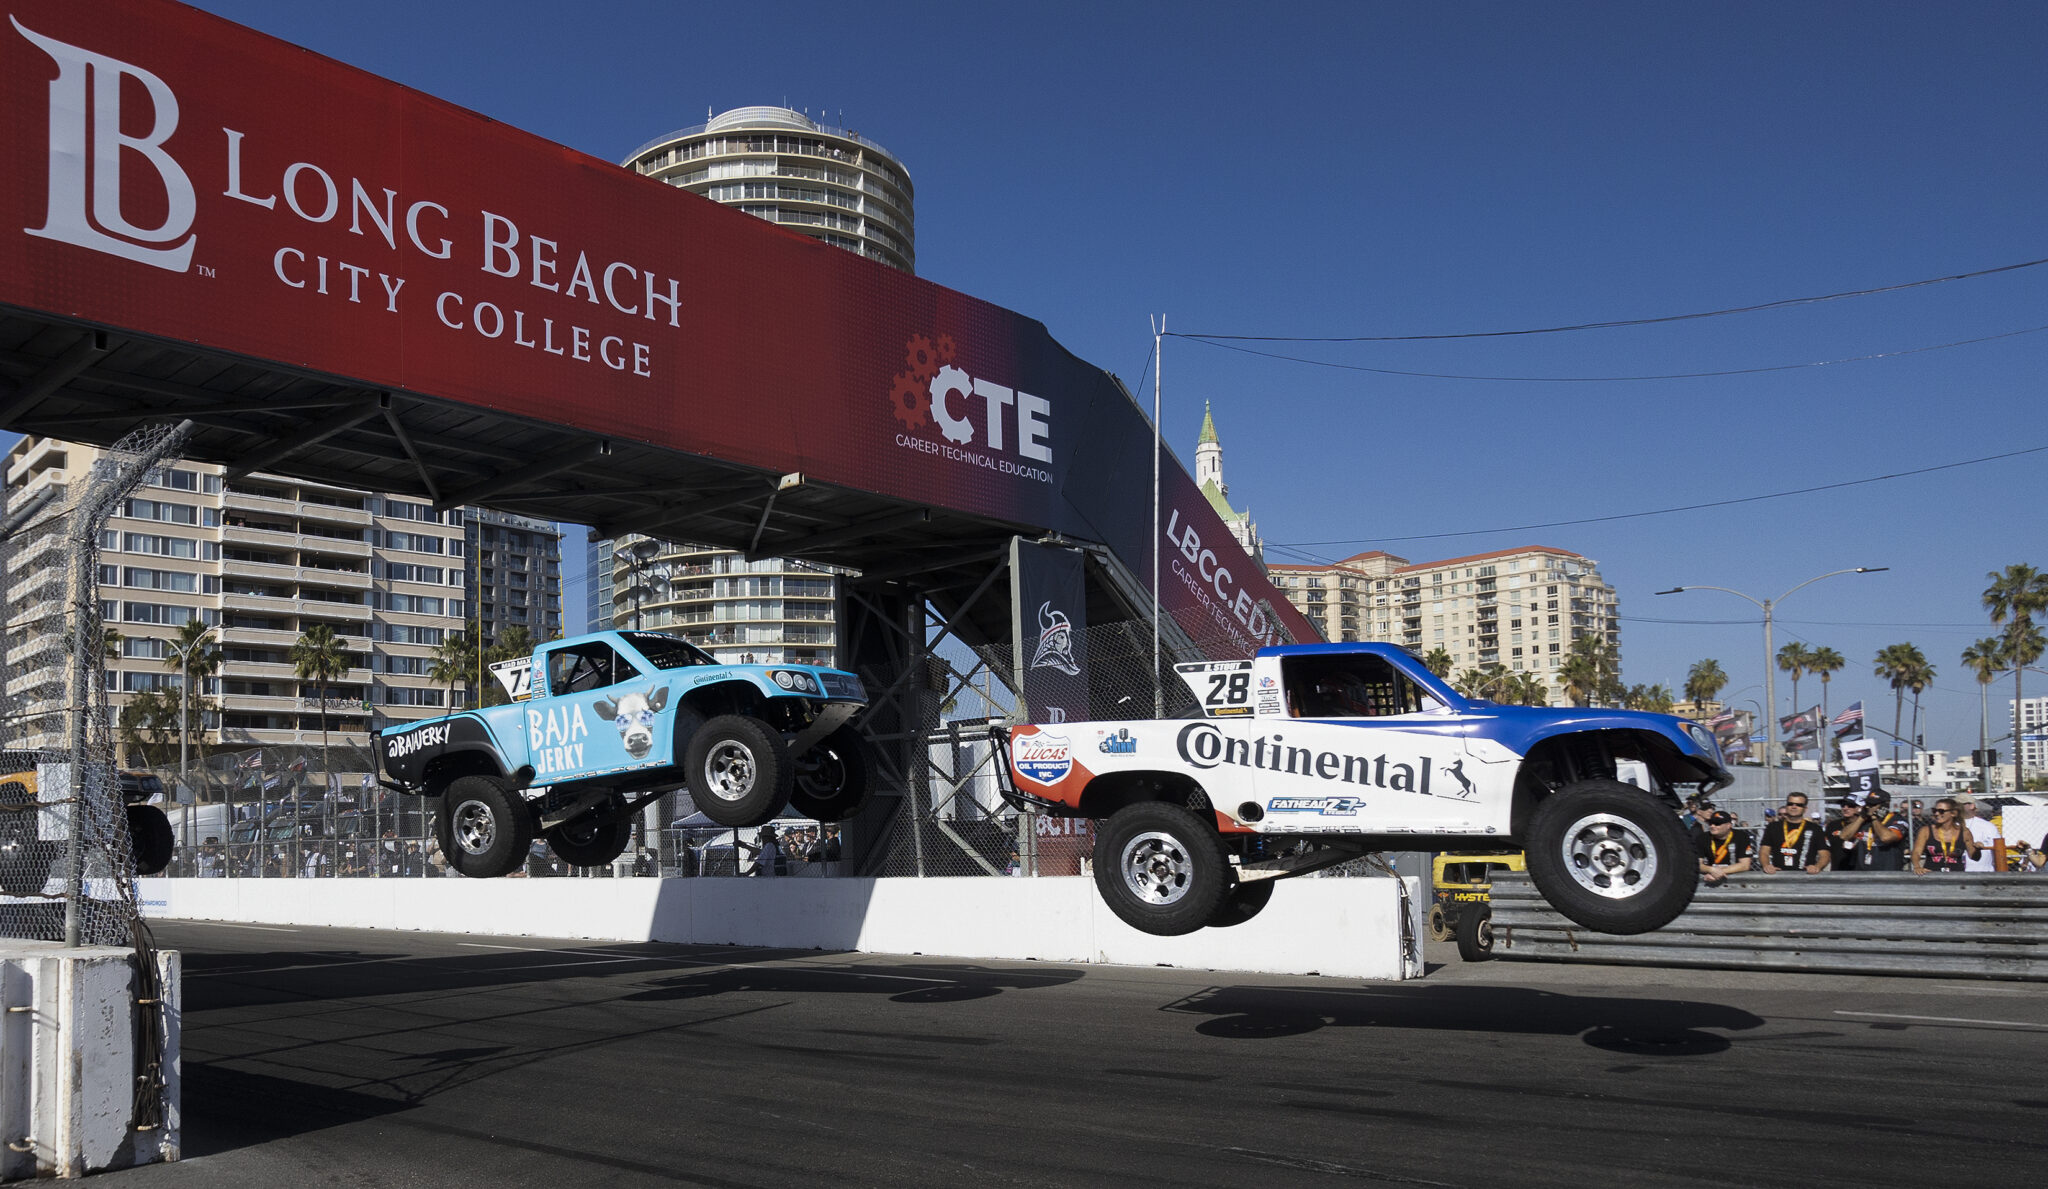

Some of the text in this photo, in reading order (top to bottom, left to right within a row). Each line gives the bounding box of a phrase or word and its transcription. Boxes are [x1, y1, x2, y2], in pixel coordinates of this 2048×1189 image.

[222, 127, 683, 328] LONG BEACH
[273, 247, 651, 378] CITY COLLEGE
[929, 364, 1053, 464] CTE
[895, 433, 1053, 485] CAREER TECHNICAL EDUCATION
[1171, 559, 1255, 658] CAREER TECHNICA
[1205, 672, 1250, 706] 28
[527, 703, 588, 751] BAJA
[537, 742, 583, 774] JERKY
[1018, 762, 1069, 770] OIL PRODUCTS
[1022, 747, 1068, 760] LUCAS
[1176, 721, 1433, 796] Continental
[1859, 775, 1872, 790] 5
[1454, 892, 1490, 902] HYSTE
